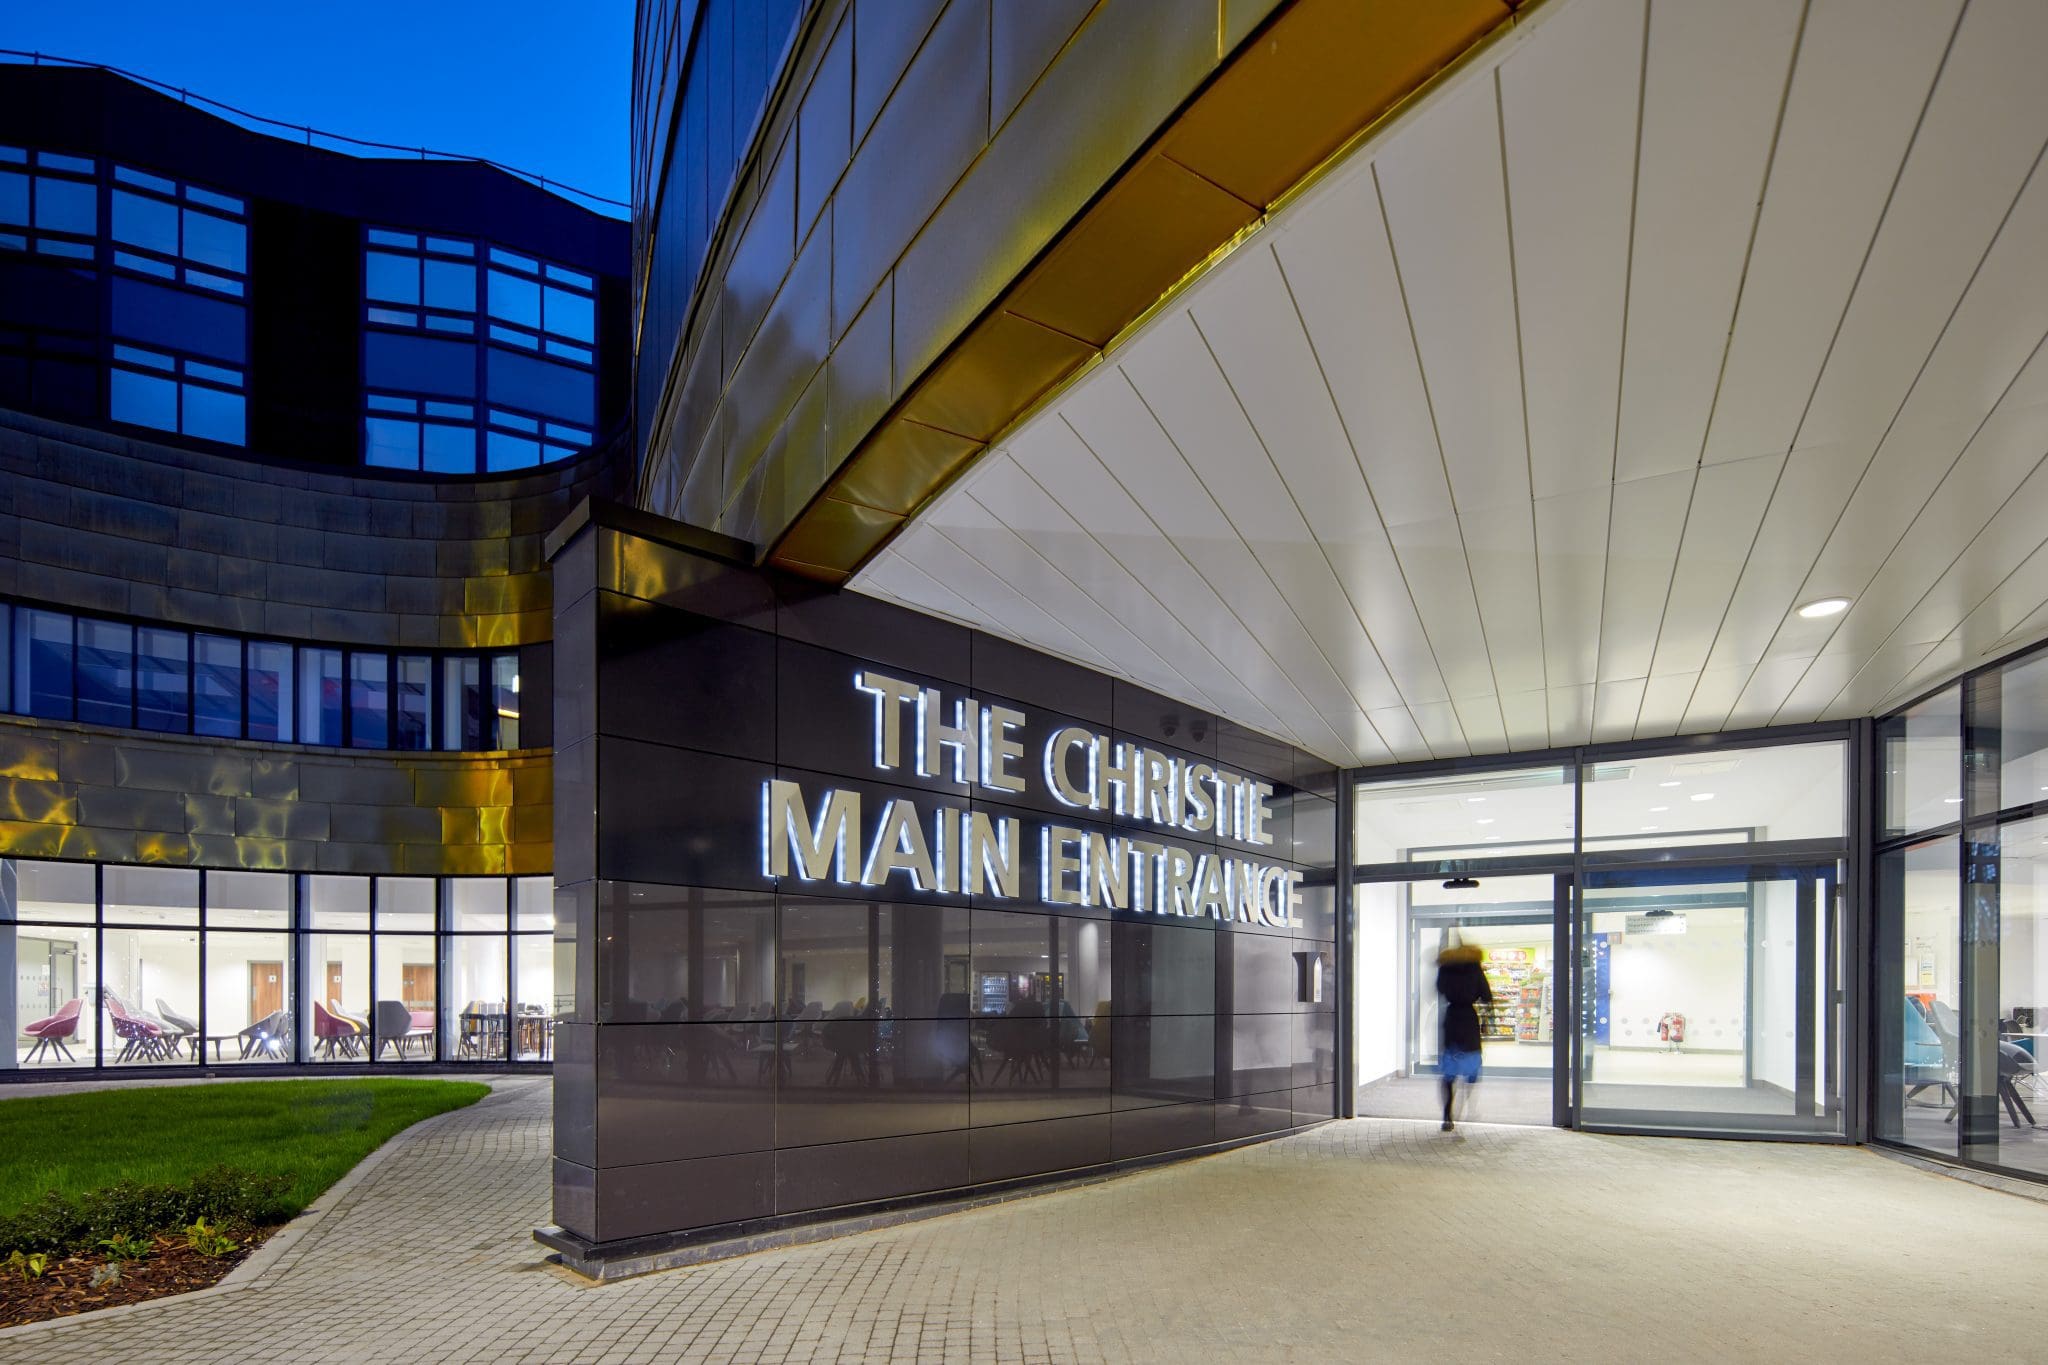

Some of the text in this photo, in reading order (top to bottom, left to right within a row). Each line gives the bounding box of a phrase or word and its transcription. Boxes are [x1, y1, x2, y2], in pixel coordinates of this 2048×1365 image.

[857, 671, 1273, 845] THE CHRISTIE
[762, 779, 1304, 929] MAIN ENTRANCE
